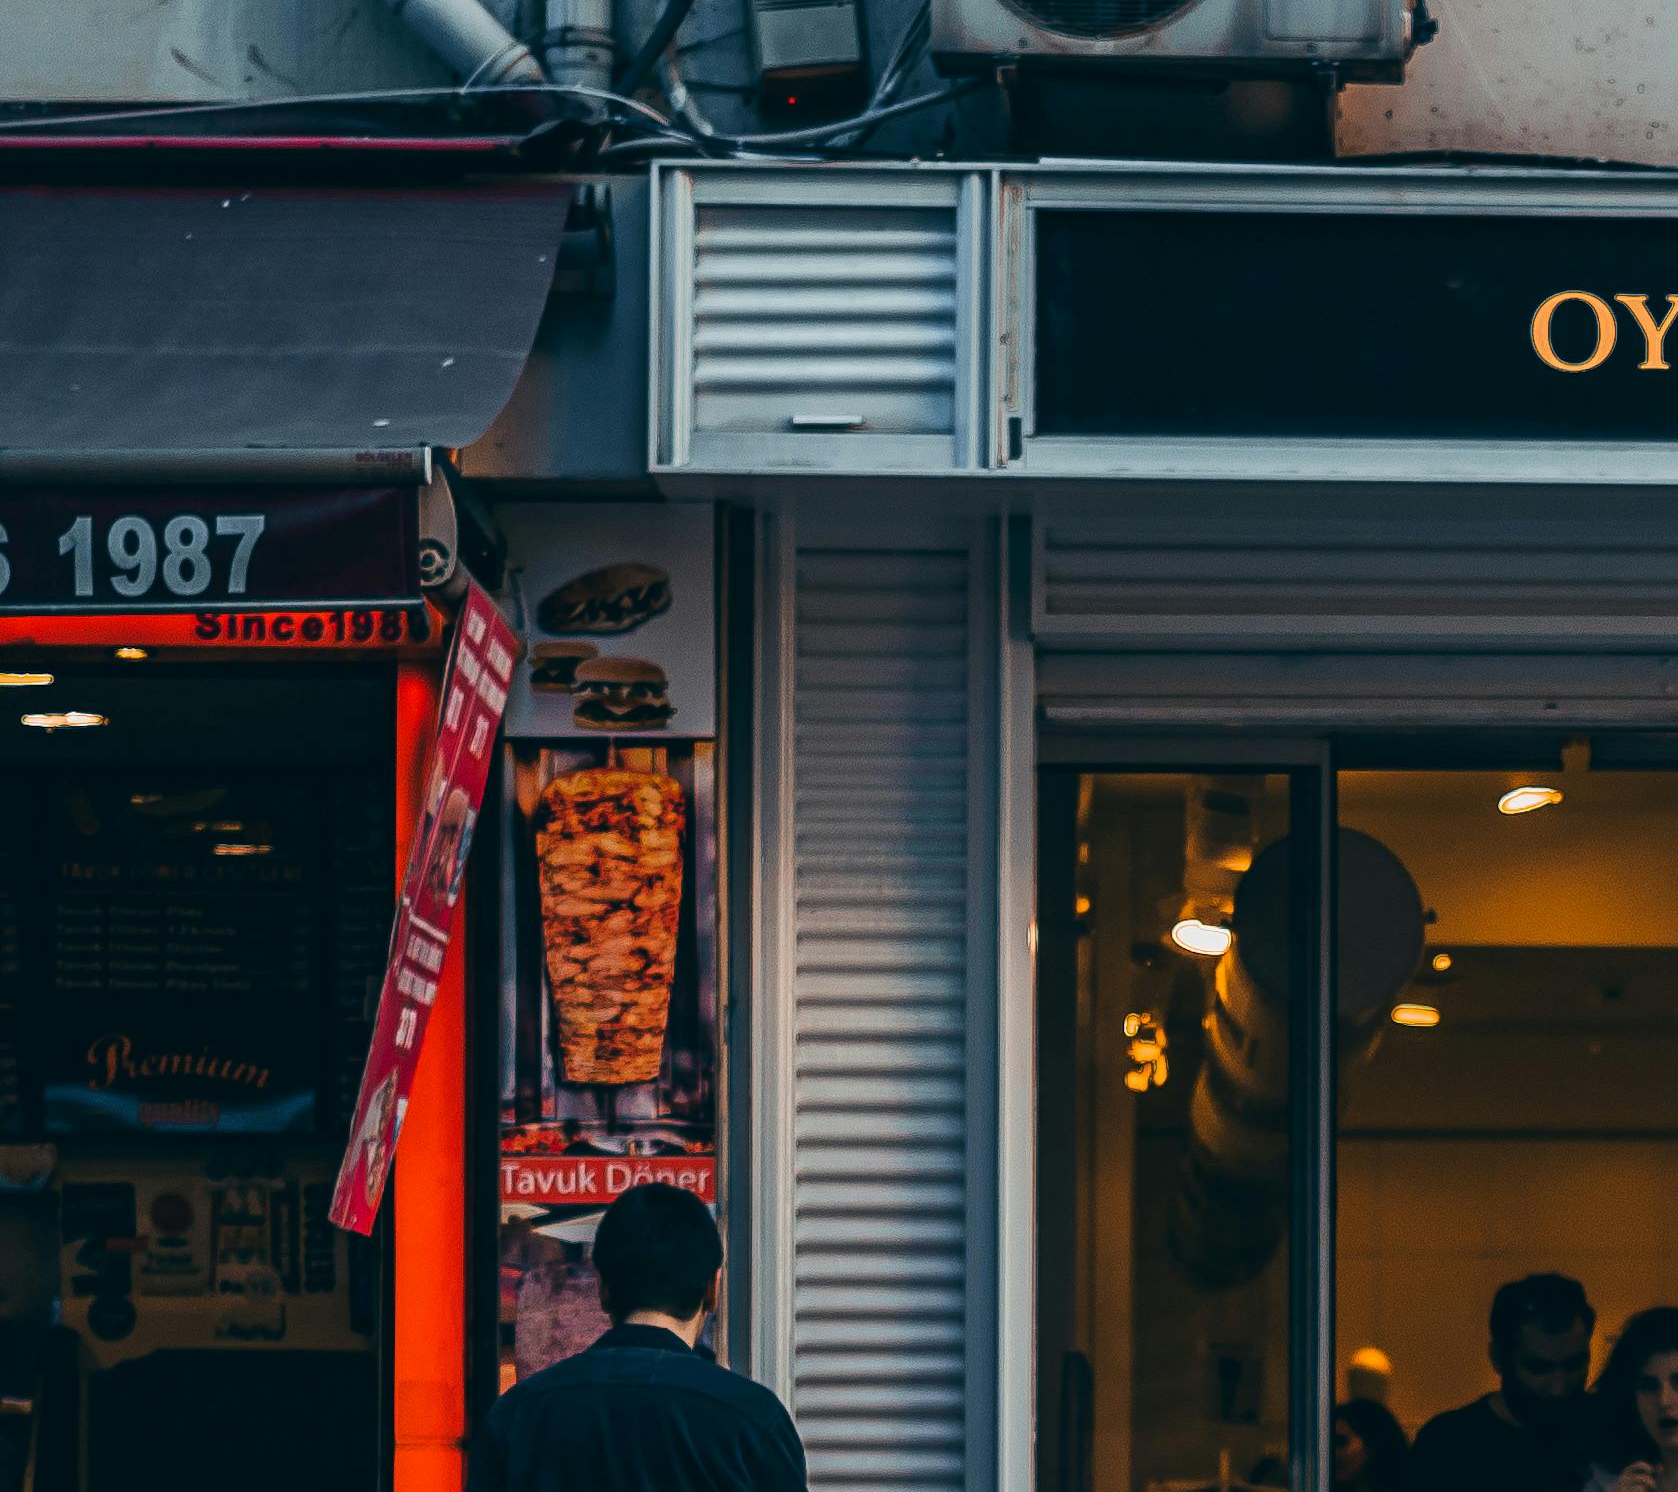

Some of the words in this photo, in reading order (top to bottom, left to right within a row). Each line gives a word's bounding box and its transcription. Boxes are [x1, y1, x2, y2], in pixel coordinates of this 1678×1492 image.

[58, 515, 265, 597] 1987
[85, 1034, 272, 1090] Premium
[501, 1159, 597, 1195] Tavuk
